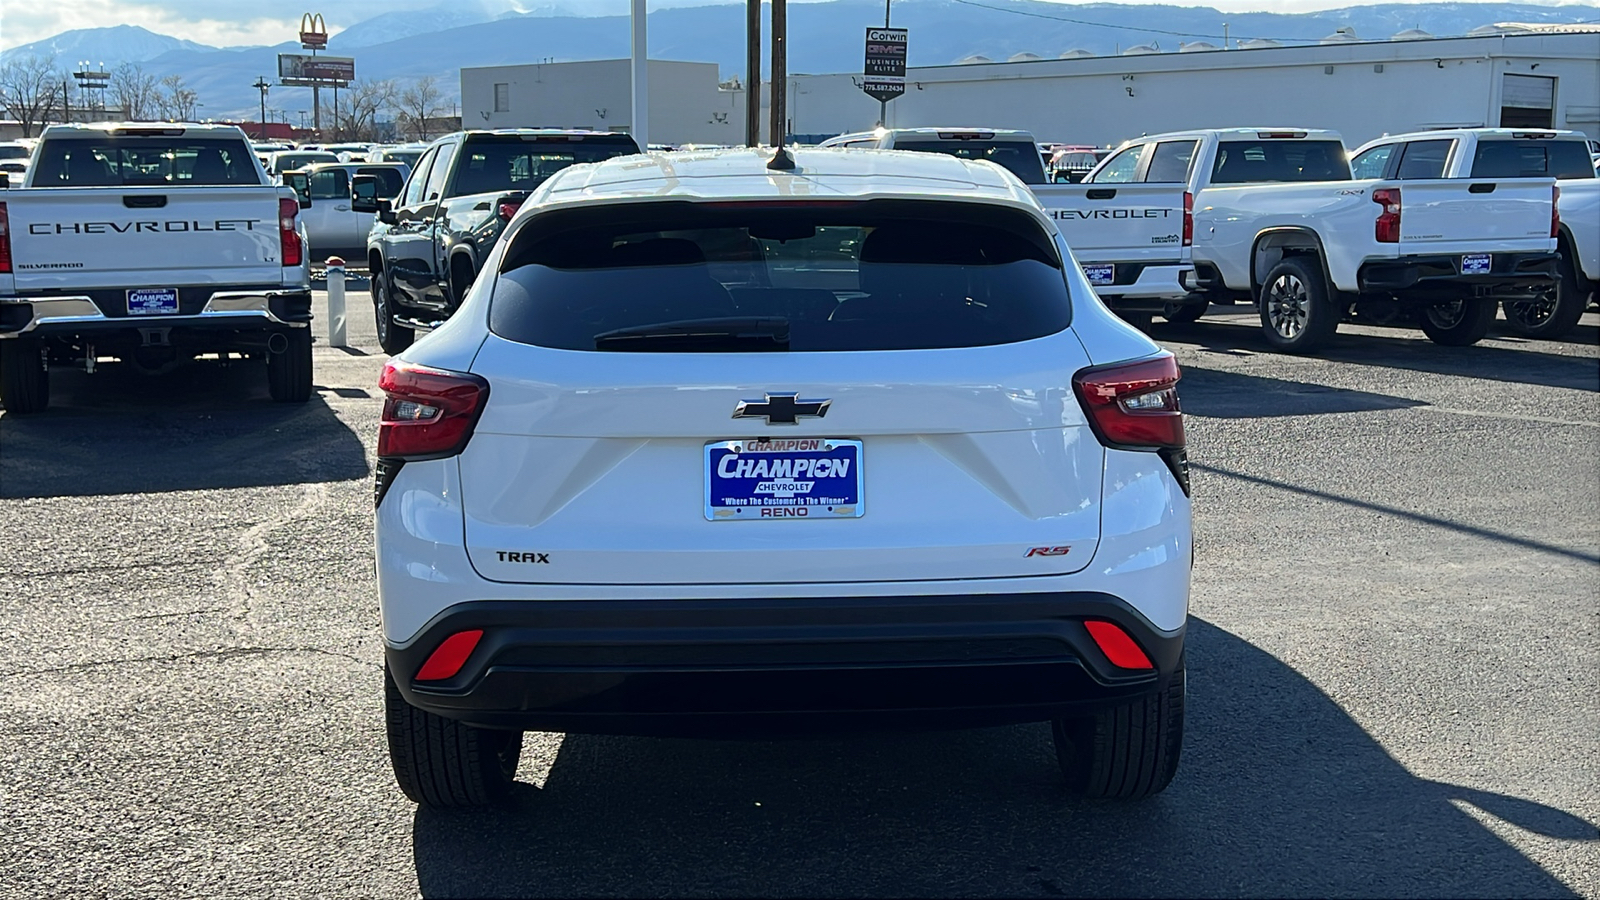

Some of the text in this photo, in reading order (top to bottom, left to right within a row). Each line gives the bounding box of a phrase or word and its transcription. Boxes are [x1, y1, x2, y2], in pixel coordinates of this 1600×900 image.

[871, 31, 907, 41] Corwin
[867, 45, 906, 54] GMC
[1050, 208, 1173, 220] HEVROLET
[29, 219, 261, 235] CHEVROLET
[18, 262, 84, 270] SILVERADO
[130, 293, 175, 302] CHAMPION
[747, 440, 819, 452] CHAMPION
[717, 453, 851, 479] CHAMPION
[758, 483, 810, 492] CHEVROLET
[749, 497, 762, 506] The
[763, 497, 797, 506] Customer
[797, 497, 805, 506] Is
[805, 497, 819, 506] The
[761, 507, 808, 518] RENO
[496, 551, 550, 564] TRAX
[1023, 546, 1071, 558] RS
